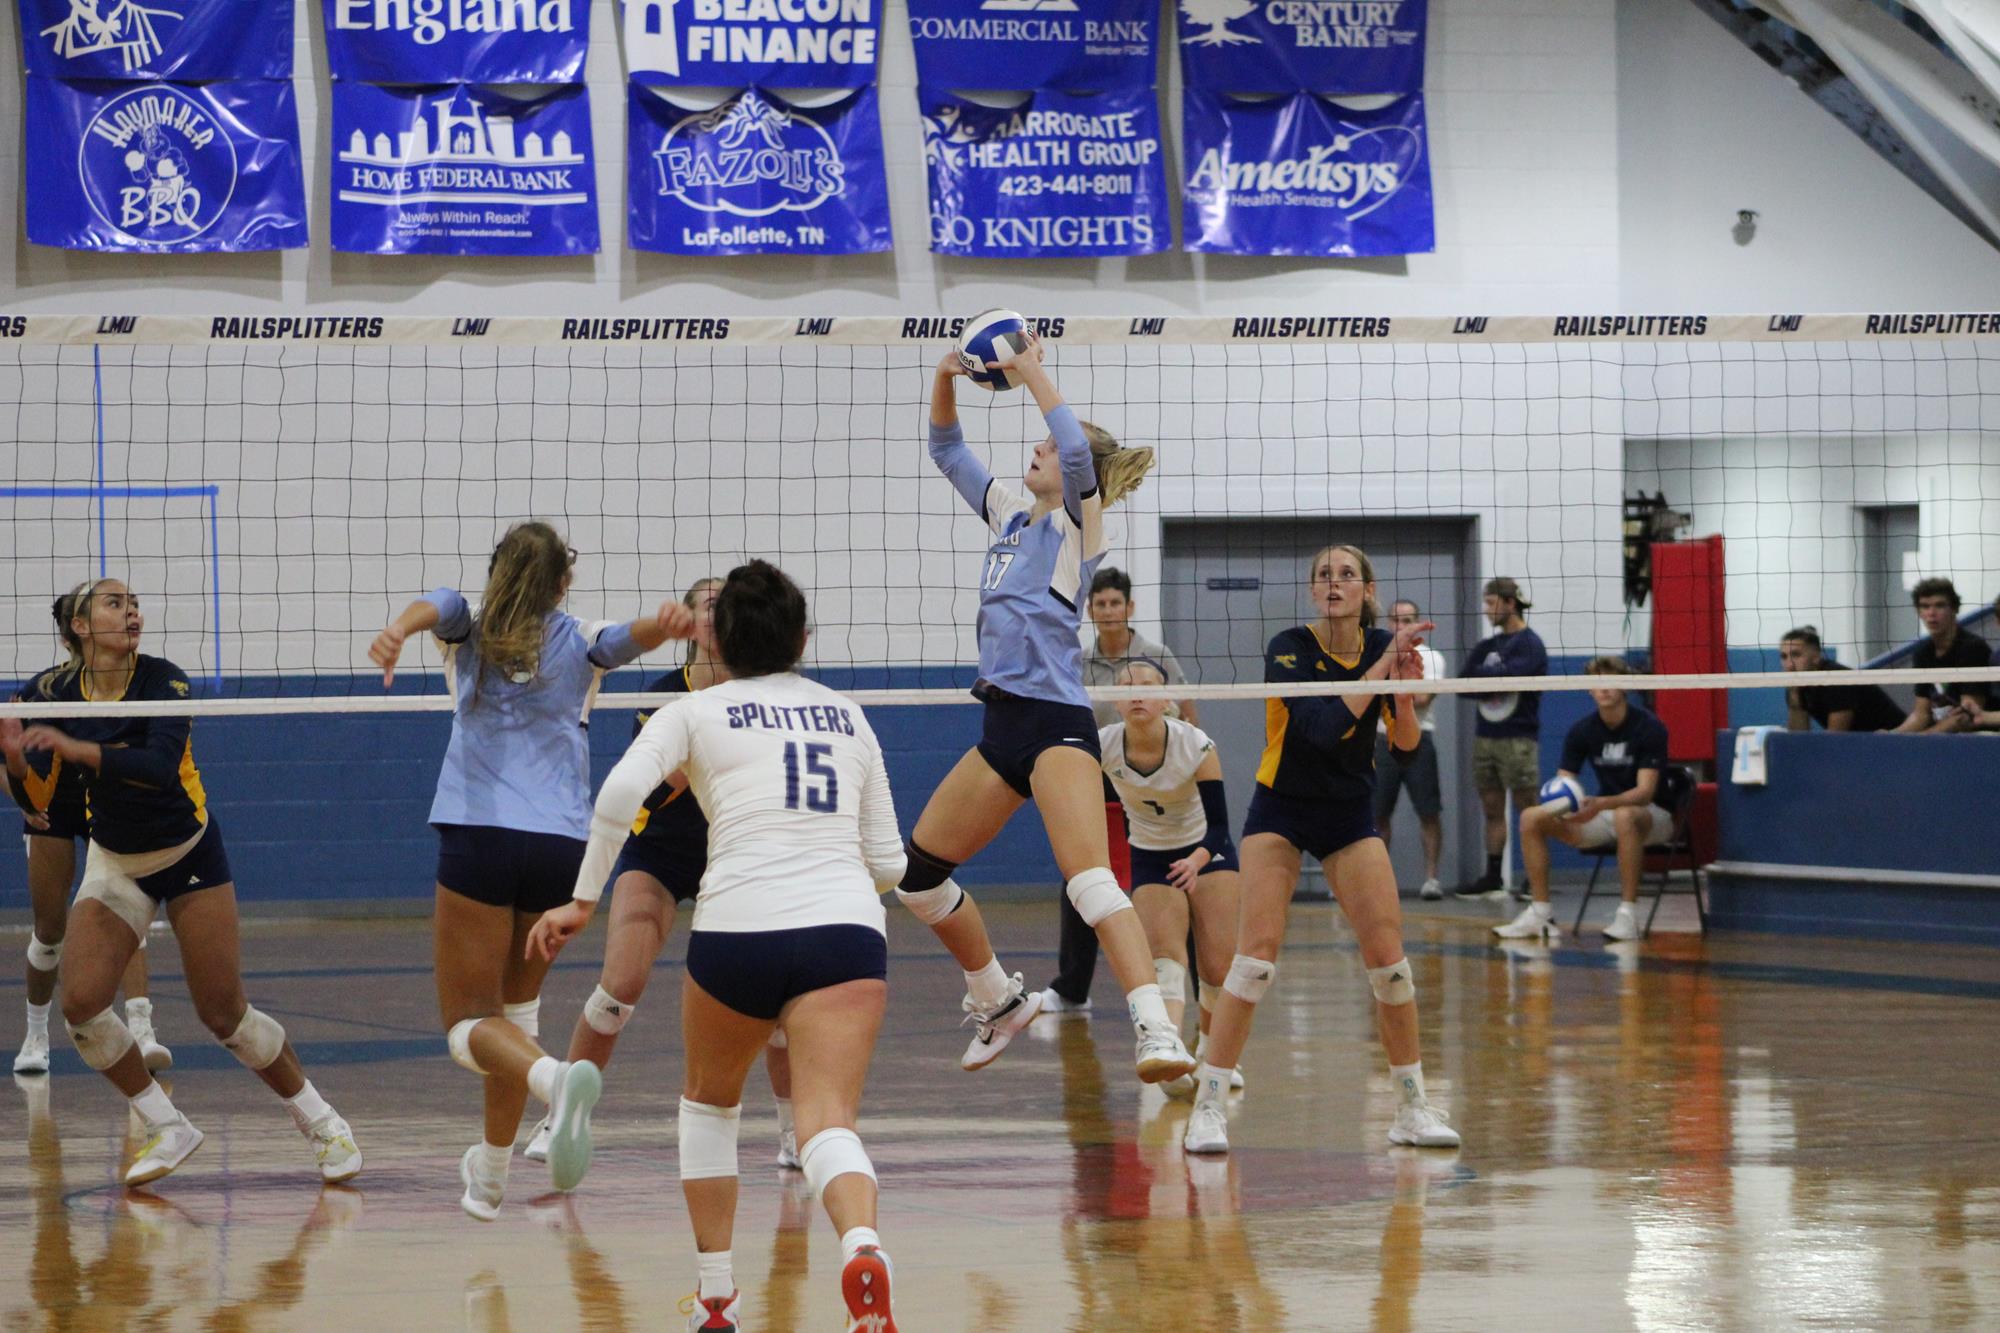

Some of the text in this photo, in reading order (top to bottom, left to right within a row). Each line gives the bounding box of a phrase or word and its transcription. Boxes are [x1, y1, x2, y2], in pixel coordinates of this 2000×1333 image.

[335, 0, 574, 44] England
[694, 0, 871, 22] BEACON
[1266, 0, 1400, 26] CENTURY
[908, 17, 1149, 42] COMMERCIAL BANK
[1296, 26, 1370, 48] BANK
[688, 26, 875, 64] FINANCE
[92, 96, 215, 150] HAYMAKER
[969, 139, 1158, 168] HEALTH GROUP
[352, 167, 572, 190] HOME FEDERAL BANK
[999, 175, 1132, 196] 423-441-8011
[1187, 145, 1399, 209] Amedisys
[120, 186, 201, 231] BBQ
[399, 211, 440, 225] Always
[441, 210, 481, 224] Within
[683, 227, 825, 246] LaFollette, TN
[982, 214, 1154, 247] KNIGHTS
[97, 316, 138, 334] LMU
[211, 316, 384, 339] RAILSPLITTERS
[452, 317, 493, 336] LMU
[562, 318, 730, 340] RAILSPLITTERS
[901, 317, 1065, 338] RAILSRS
[1129, 317, 1167, 335] LMU
[1233, 316, 1390, 338] RAILSPLITTERS
[1453, 316, 1490, 334] LMU
[1554, 316, 1707, 336] RAILSPLITTERS
[1768, 315, 1803, 332] LMU
[1865, 314, 2000, 334] RAILSPLITTER
[983, 551, 1016, 591] 17
[726, 702, 855, 737] SPLITTERS
[783, 741, 839, 814] 15
